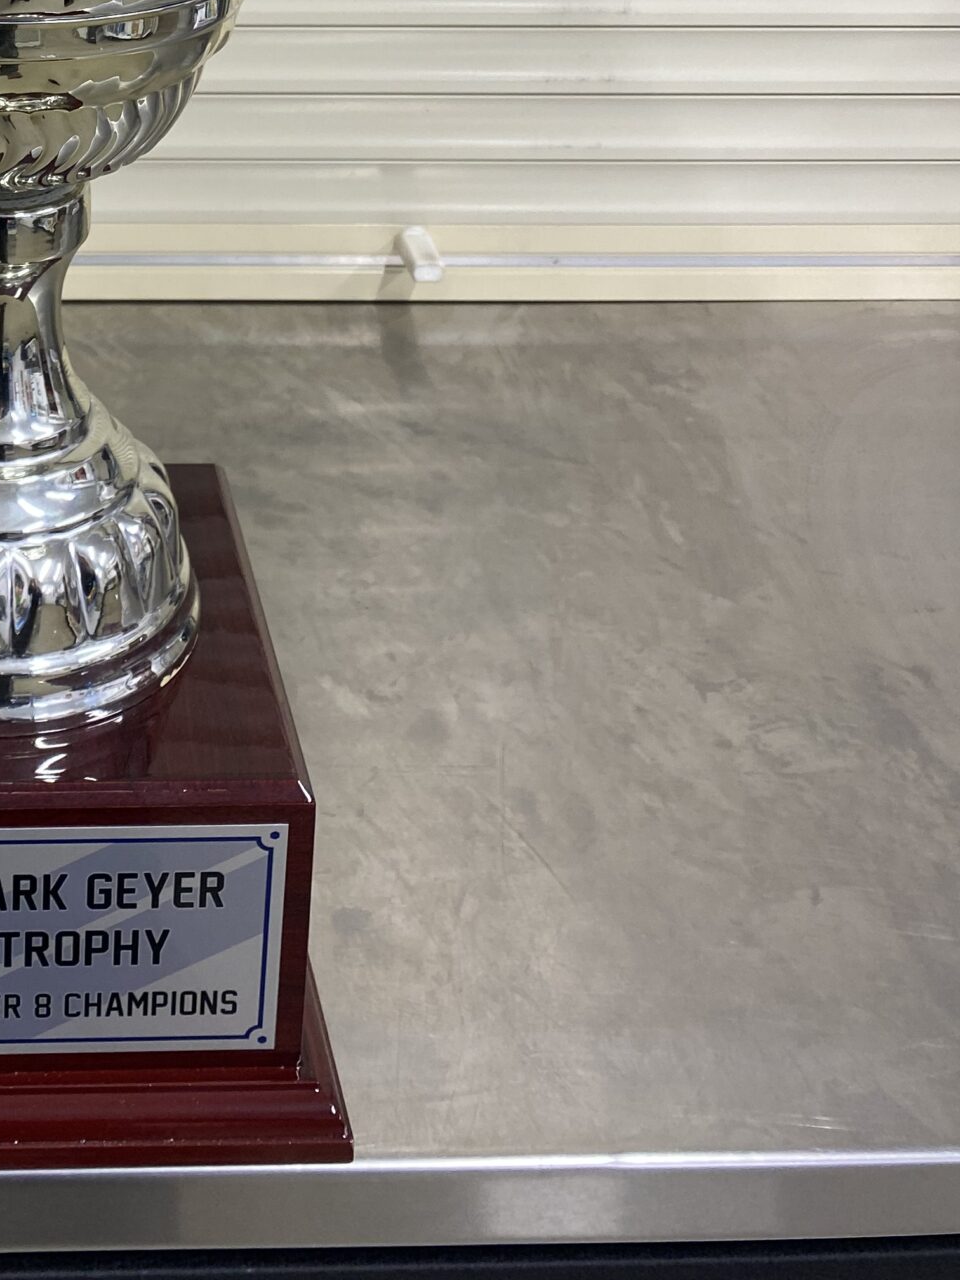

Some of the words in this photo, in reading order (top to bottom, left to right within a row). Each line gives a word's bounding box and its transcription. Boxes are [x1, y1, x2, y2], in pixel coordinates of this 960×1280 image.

[85, 871, 226, 910] GEYER
[34, 993, 52, 1018] 8
[63, 989, 238, 1018] CHAMPIONS
